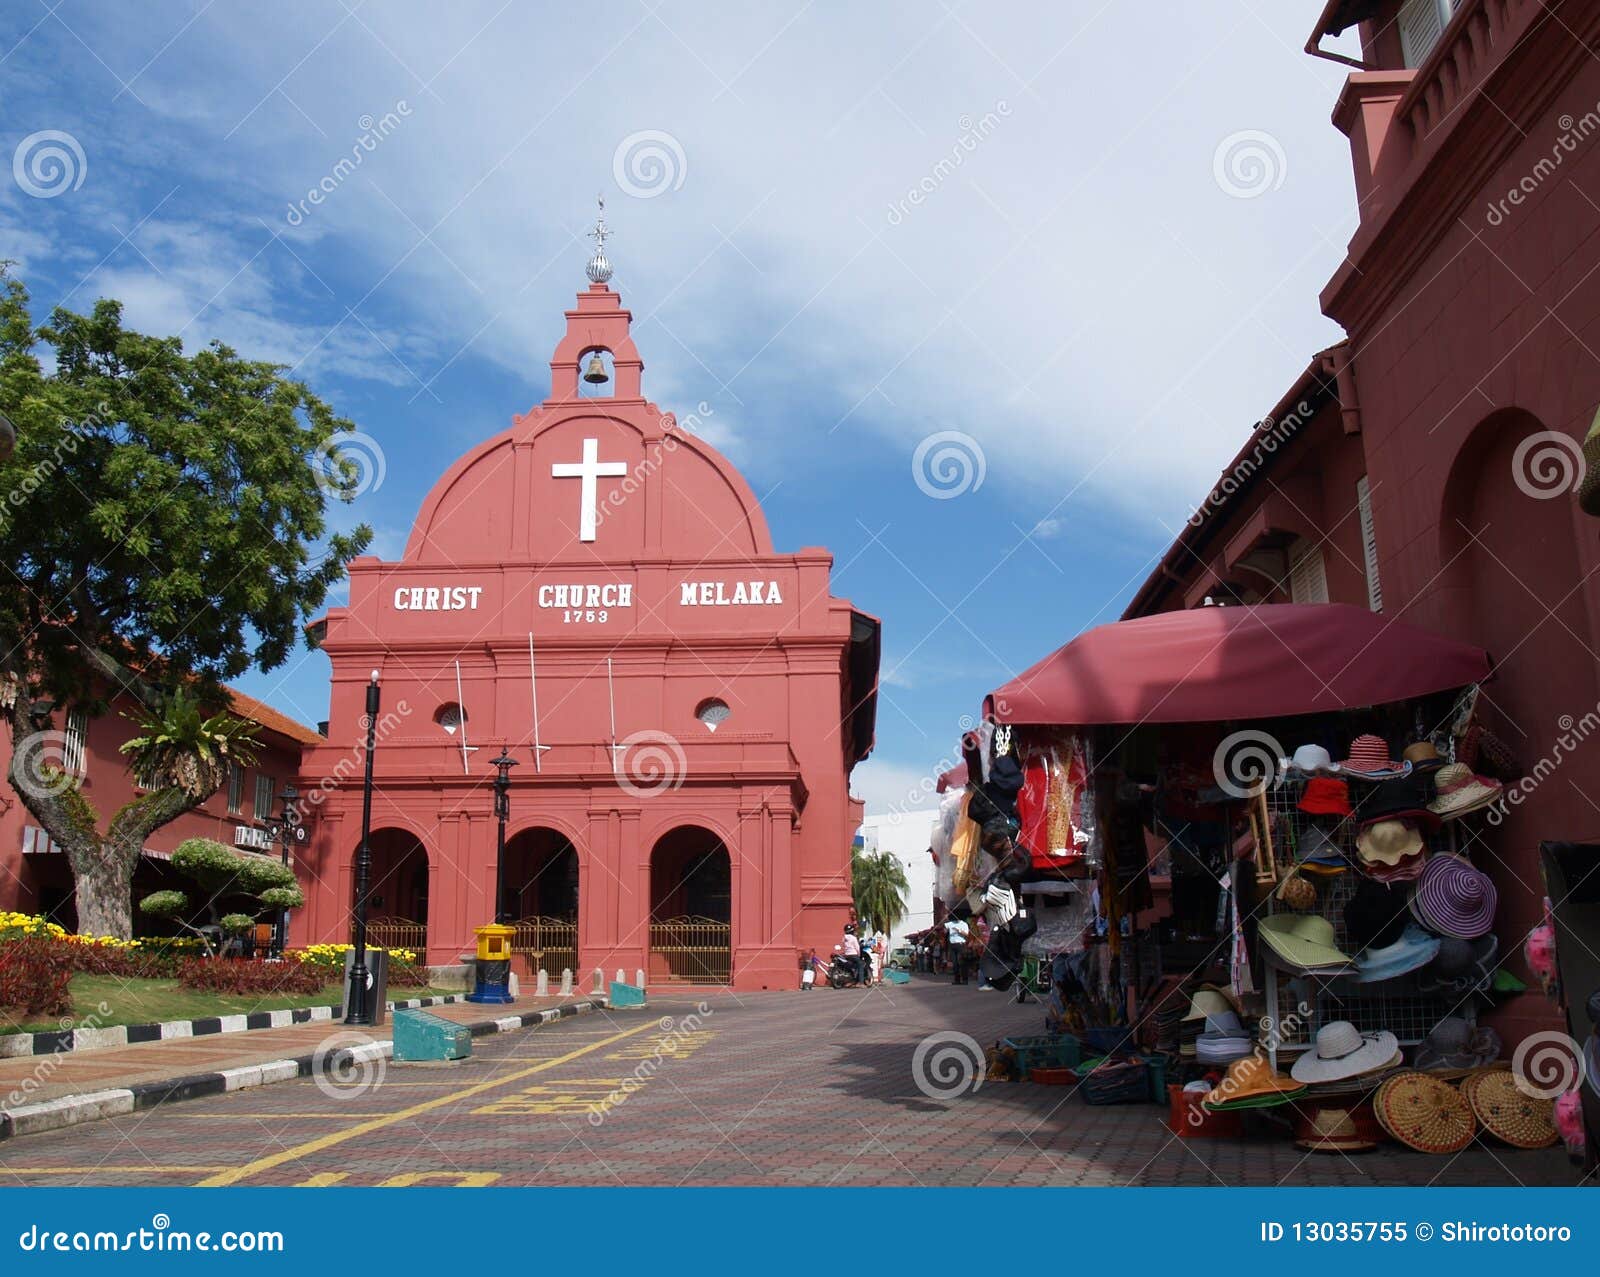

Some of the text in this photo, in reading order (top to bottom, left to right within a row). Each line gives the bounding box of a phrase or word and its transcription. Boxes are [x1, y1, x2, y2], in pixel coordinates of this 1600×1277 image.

[393, 581, 783, 610] CHRIST CHURCH MELAKA
[563, 610, 608, 623] 1753
